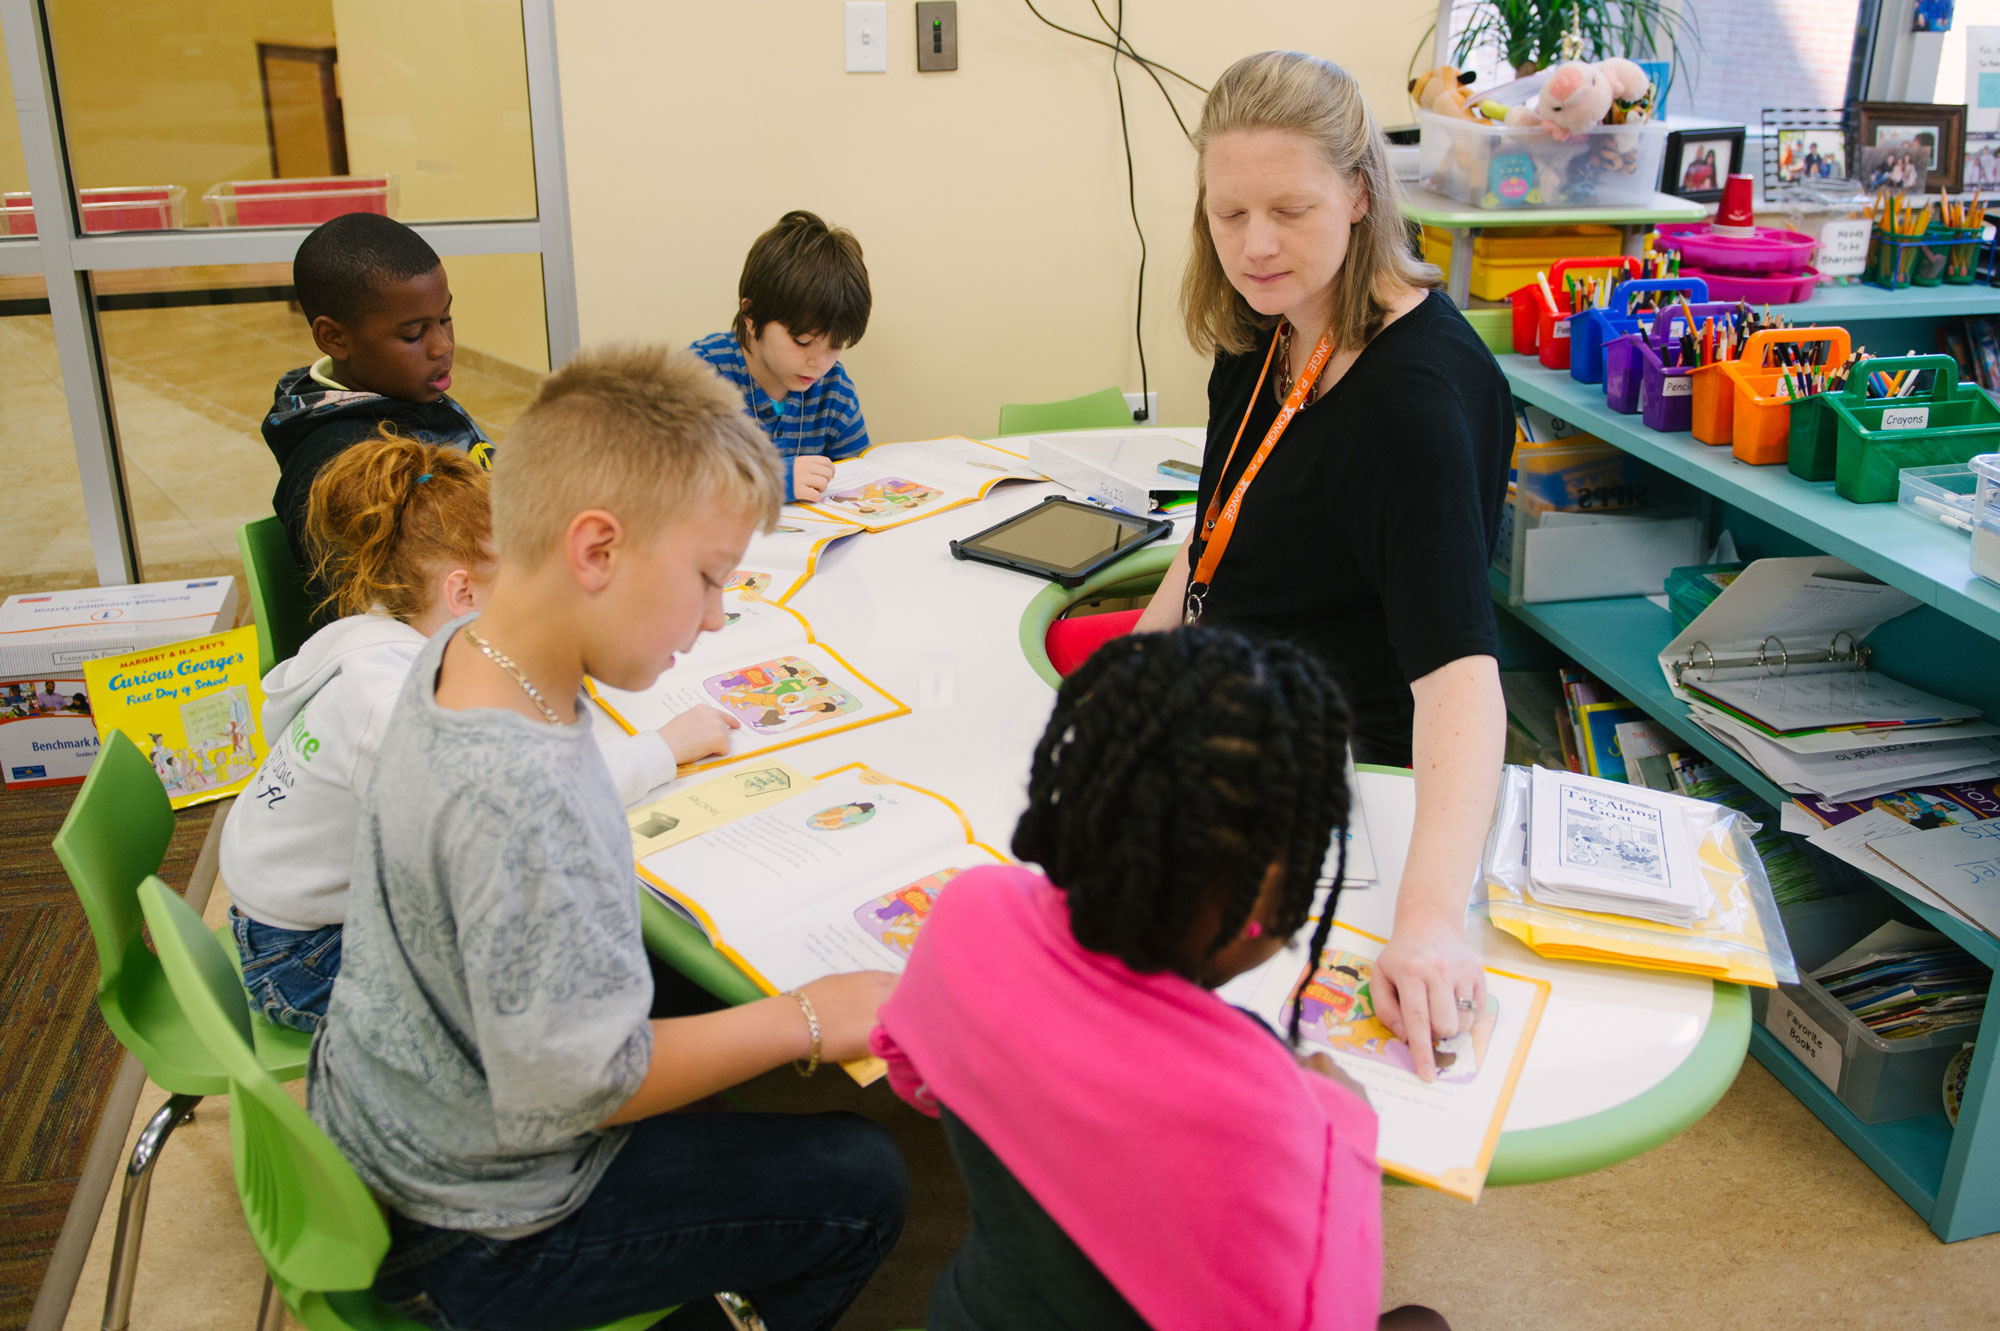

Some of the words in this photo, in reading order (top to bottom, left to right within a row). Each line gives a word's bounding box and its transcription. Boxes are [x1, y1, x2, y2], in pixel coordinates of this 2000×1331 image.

[1307, 337, 1332, 374] ONGE
[1886, 414, 1924, 427] Crayons
[108, 669, 174, 691] Curious
[177, 652, 244, 676] George's
[120, 653, 166, 669] MARGRET
[126, 692, 153, 706] First
[156, 688, 178, 699] Day
[181, 686, 191, 697] of
[194, 674, 229, 690] School
[32, 737, 91, 752] Benchmark
[1564, 788, 1658, 822] Tag-Along
[1590, 805, 1632, 823] Goat
[1786, 1008, 1823, 1049] Favorite
[1789, 1027, 1816, 1058] Books
